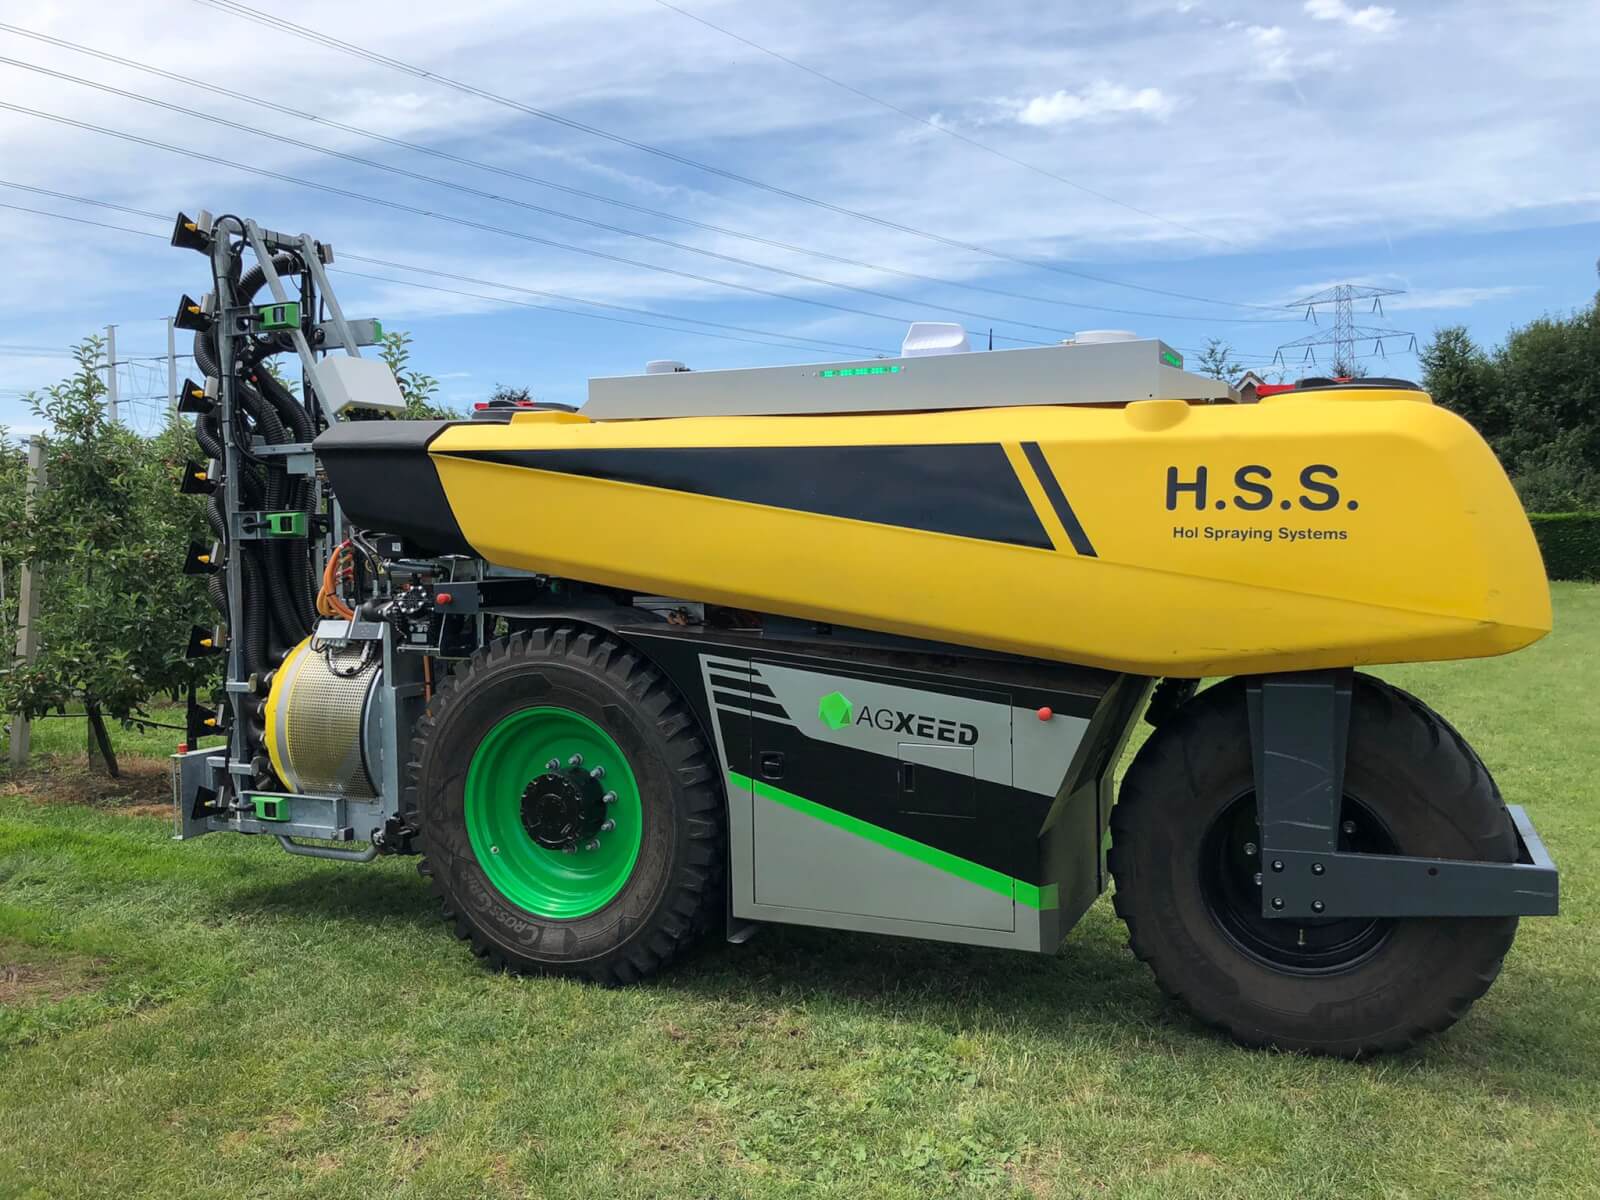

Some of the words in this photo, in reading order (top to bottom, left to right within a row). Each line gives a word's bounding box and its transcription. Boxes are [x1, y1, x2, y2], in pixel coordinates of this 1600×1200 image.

[1166, 464, 1359, 511] H.S.S.
[1173, 527, 1199, 539] Hol
[1204, 527, 1273, 542] Spraying
[1278, 527, 1348, 542] Systems
[856, 705, 979, 746] AGXEED
